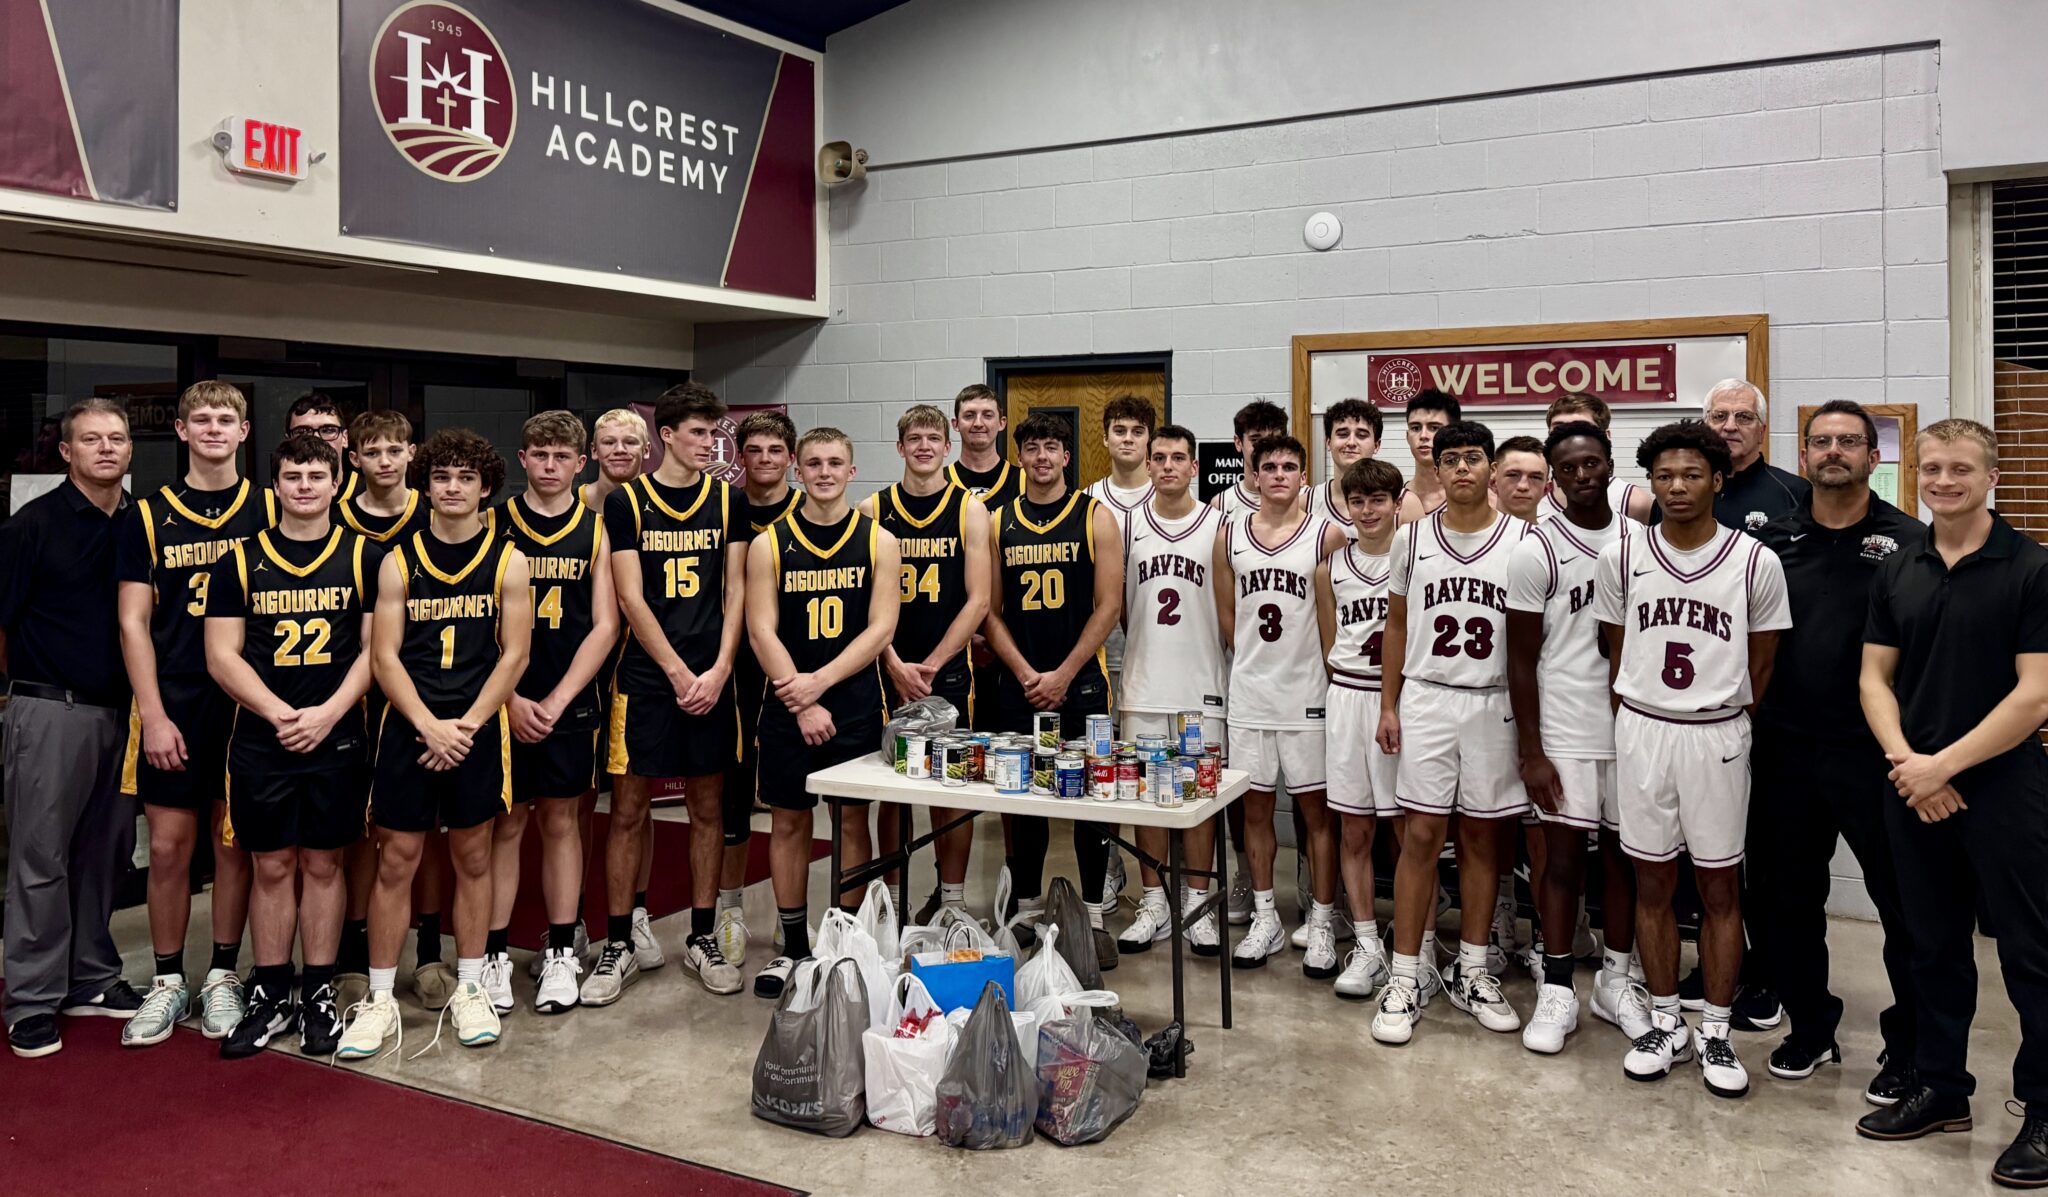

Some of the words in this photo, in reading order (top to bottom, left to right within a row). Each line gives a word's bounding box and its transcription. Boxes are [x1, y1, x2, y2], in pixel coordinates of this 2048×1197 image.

[430, 19, 463, 38] 1945
[531, 71, 740, 156] HILLCREST
[244, 119, 301, 176] EXIT
[546, 124, 729, 194] ACADEMY
[1382, 360, 1418, 375] HILLCREST
[1428, 357, 1662, 396] WELCOME
[1382, 387, 1417, 401] ACADEMY
[1208, 473, 1245, 485] OFFIC
[1215, 457, 1244, 468] MAIN
[164, 537, 250, 569] SIGOUR
[642, 528, 721, 552] SIGOURNEY
[896, 537, 957, 558] OURNEY
[1004, 542, 1080, 567] SIGOURNEY
[1861, 535, 1899, 551] RAVENS
[525, 556, 588, 581] OURNEY
[664, 557, 700, 598] 15
[784, 566, 866, 593] SIGOURNEY
[899, 563, 941, 603] 34
[1138, 554, 1205, 588] RAVENS
[1240, 567, 1307, 600] RAVENS
[251, 586, 353, 615] SIGOURNEY
[1020, 569, 1065, 610] 20
[1157, 587, 1181, 626] 2
[1423, 576, 1507, 614] RAVENS
[407, 593, 494, 622] SIGOURNEY
[806, 595, 844, 640] 10
[1258, 603, 1283, 643] 3
[1340, 597, 1389, 627] RAVE
[1637, 597, 1733, 643] RAVENS
[273, 617, 332, 667] 22
[440, 625, 456, 670] 1
[1358, 630, 1384, 667] 4
[1431, 614, 1495, 661] 23
[1661, 640, 1696, 690] 5
[664, 780, 686, 790] HILL
